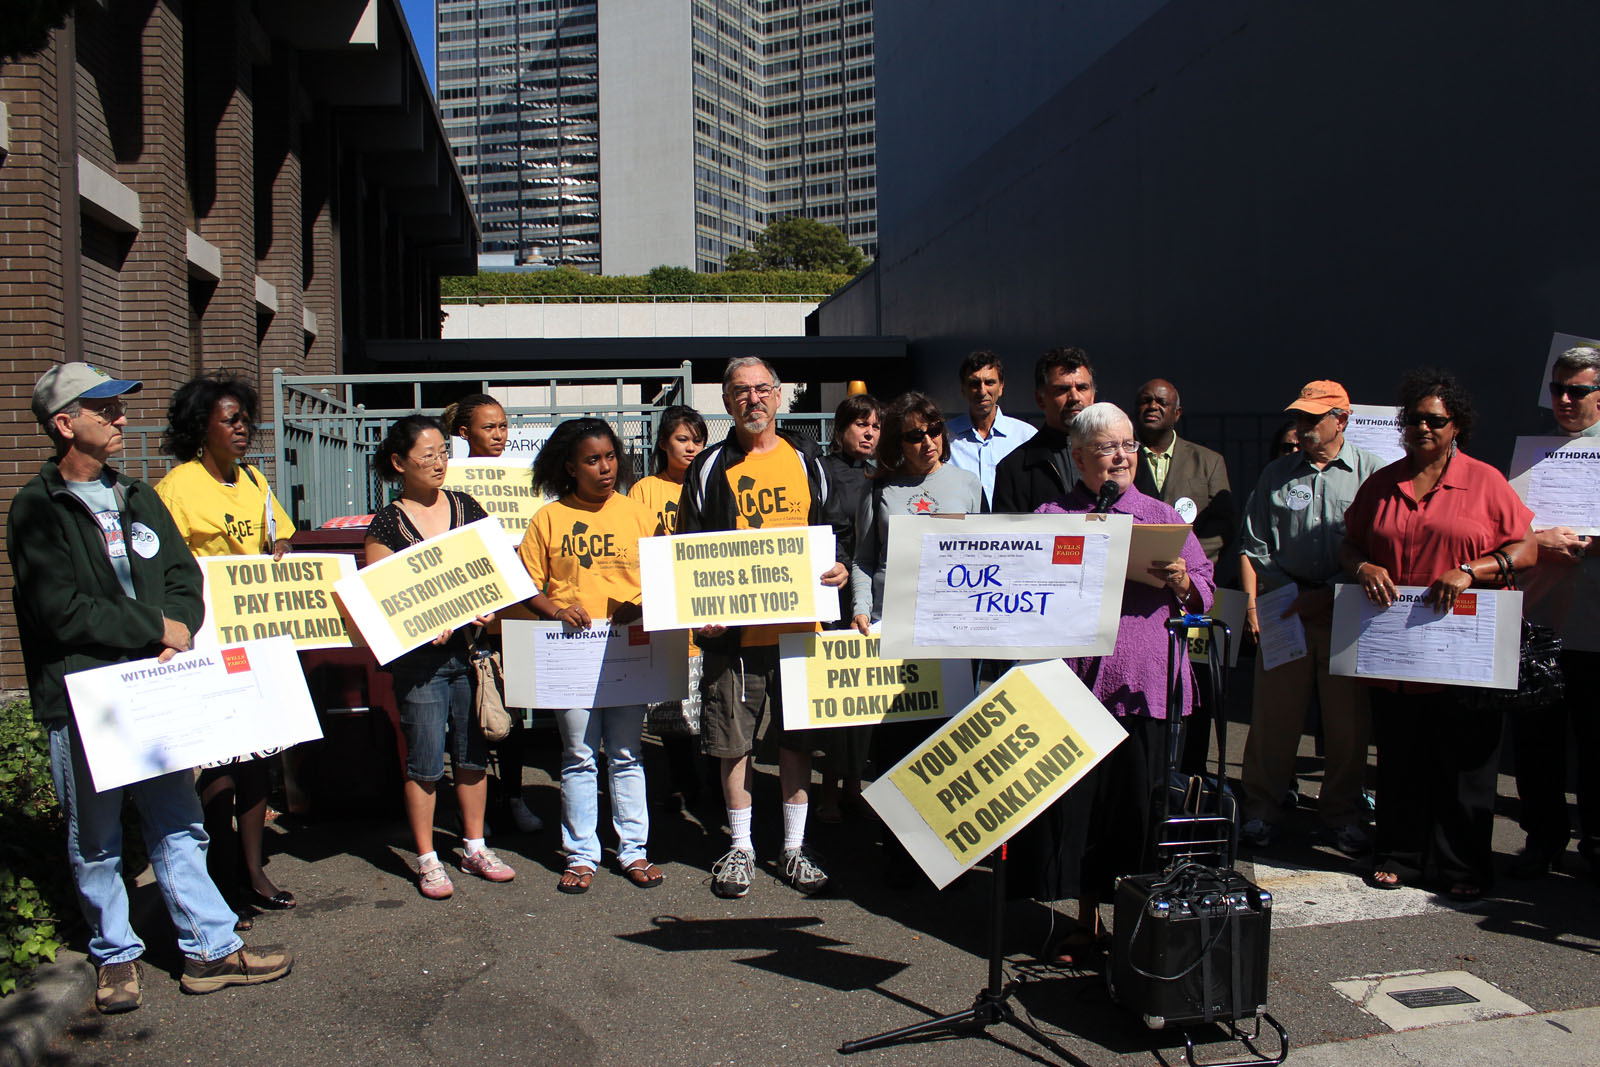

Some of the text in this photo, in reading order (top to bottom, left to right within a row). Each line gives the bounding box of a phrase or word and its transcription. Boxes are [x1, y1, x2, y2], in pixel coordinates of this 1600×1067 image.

[465, 468, 506, 480] STOP
[486, 501, 519, 513] OUR
[737, 486, 789, 517] CCE
[561, 533, 616, 557] ACCE
[675, 536, 805, 561] Homeowners pay
[939, 540, 1043, 551] WITHDRAWAL
[406, 546, 443, 574] STOP
[226, 561, 323, 586] YOU MUST
[693, 564, 793, 588] taxes & fines,
[947, 564, 1003, 588] OUR
[381, 556, 495, 618] DESTROYING OUR
[233, 589, 328, 616] PAY FINES
[403, 582, 504, 638] COMMUNITIES!
[691, 591, 799, 617] WHY NOT YOU?
[968, 590, 1055, 616] TRUST
[220, 617, 349, 644] TO OAKLAND!
[546, 630, 621, 640] WITHDRAWAL
[822, 639, 860, 660] YOU
[120, 656, 215, 683] WITHDRAWAL
[827, 663, 919, 689] PAY FINES
[812, 690, 939, 718] TO OAKLAND!
[907, 689, 1017, 785] YOU MUST
[936, 723, 1040, 814] PAY FINES
[945, 735, 1085, 853] TO OAKLAND!
